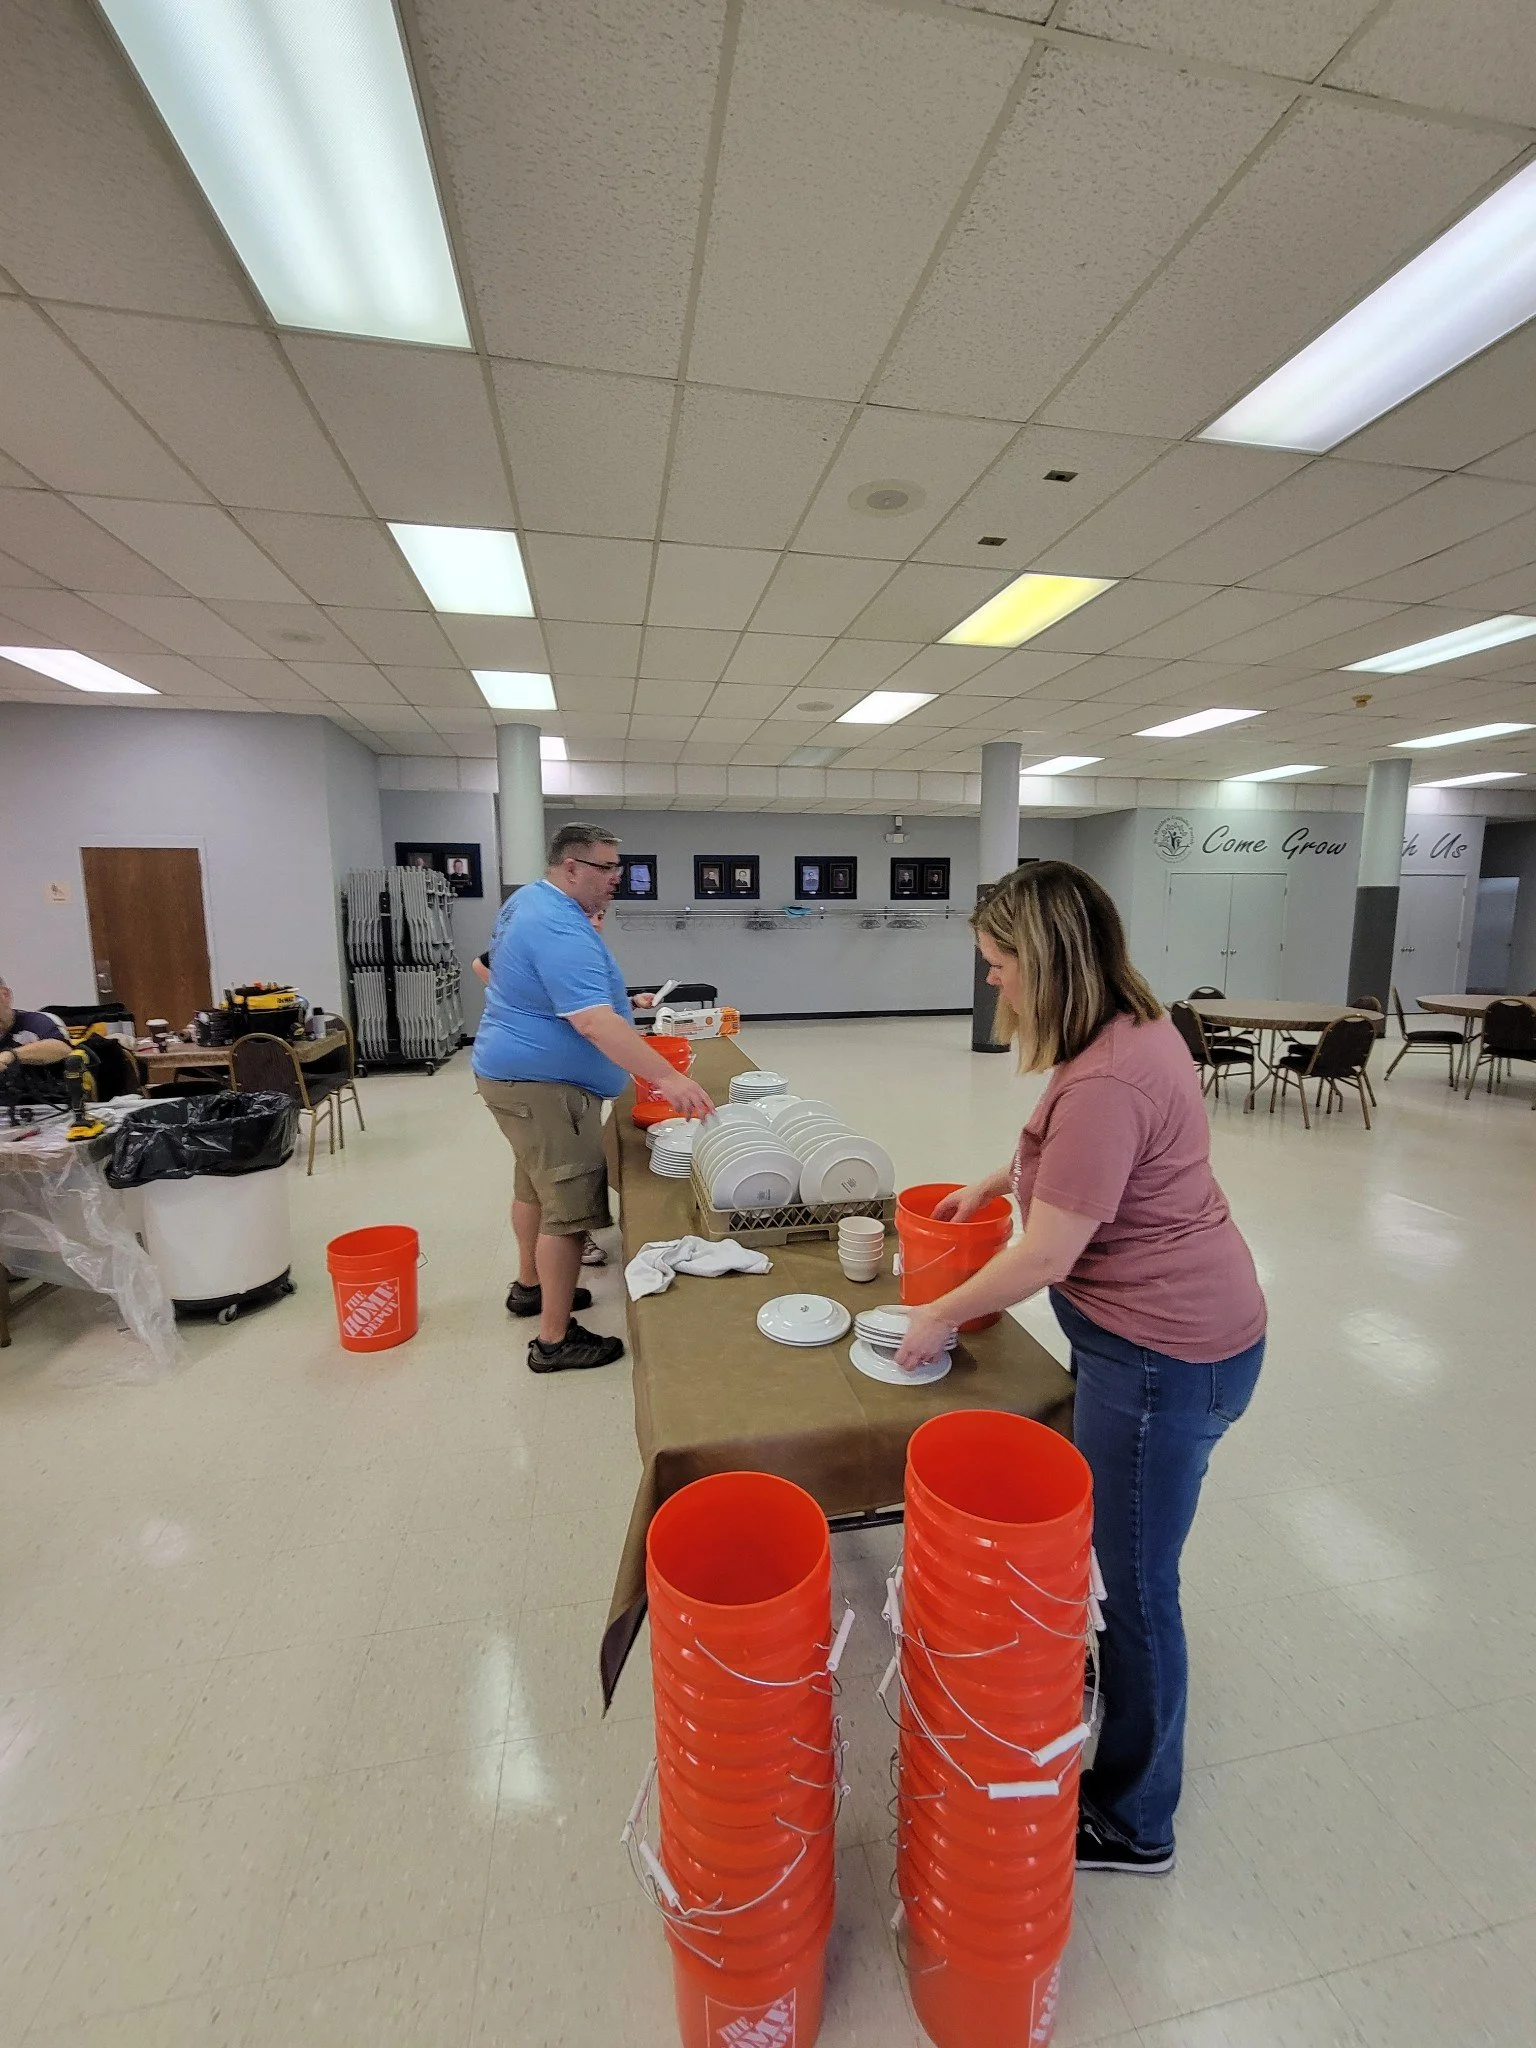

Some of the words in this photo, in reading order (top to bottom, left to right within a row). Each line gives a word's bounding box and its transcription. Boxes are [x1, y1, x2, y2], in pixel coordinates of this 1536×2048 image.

[1202, 825, 1268, 854] Come
[1281, 827, 1347, 860] Grow
[1430, 833, 1467, 858] Us
[343, 1281, 399, 1337] HOME
[345, 1290, 367, 1311] THE
[362, 1299, 398, 1336] DEPOT
